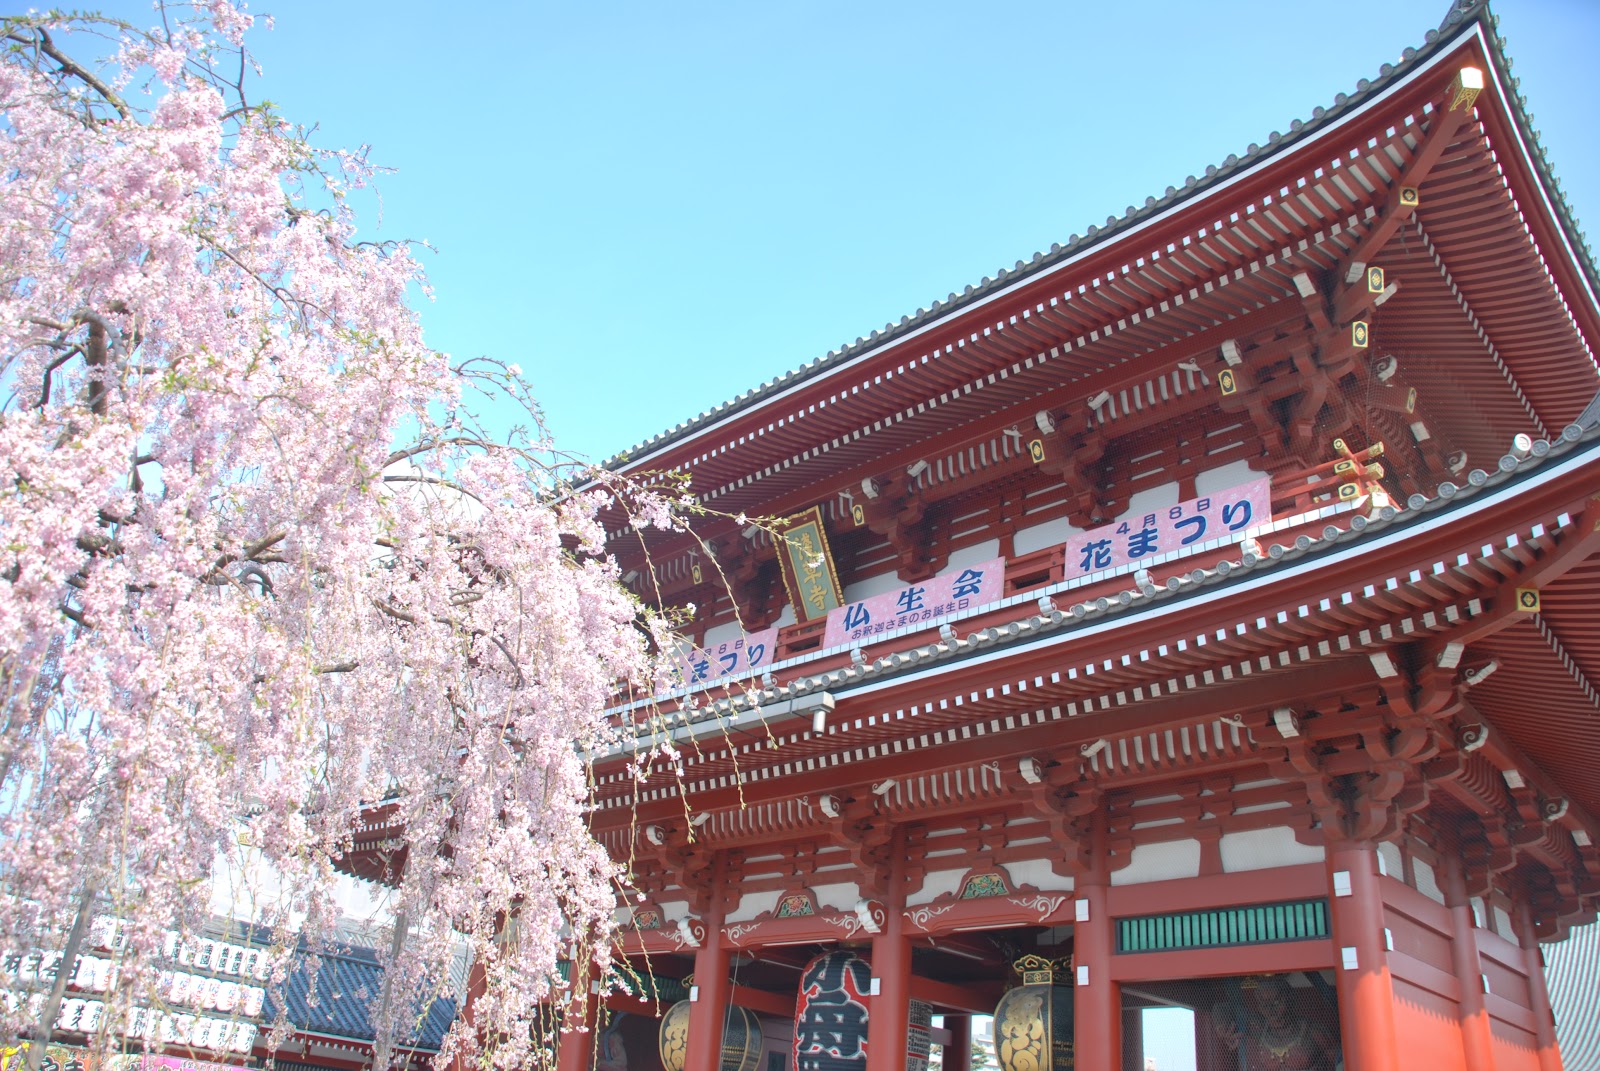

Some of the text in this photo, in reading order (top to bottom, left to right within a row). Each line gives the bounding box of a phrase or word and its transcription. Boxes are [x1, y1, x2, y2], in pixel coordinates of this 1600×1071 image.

[1080, 500, 1252, 571] 花まつり
[1116, 498, 1210, 535] 4月8日
[843, 569, 984, 632] 仏生会
[851, 598, 969, 640] お釈迦さまのお誕生日
[670, 643, 765, 689] まつり
